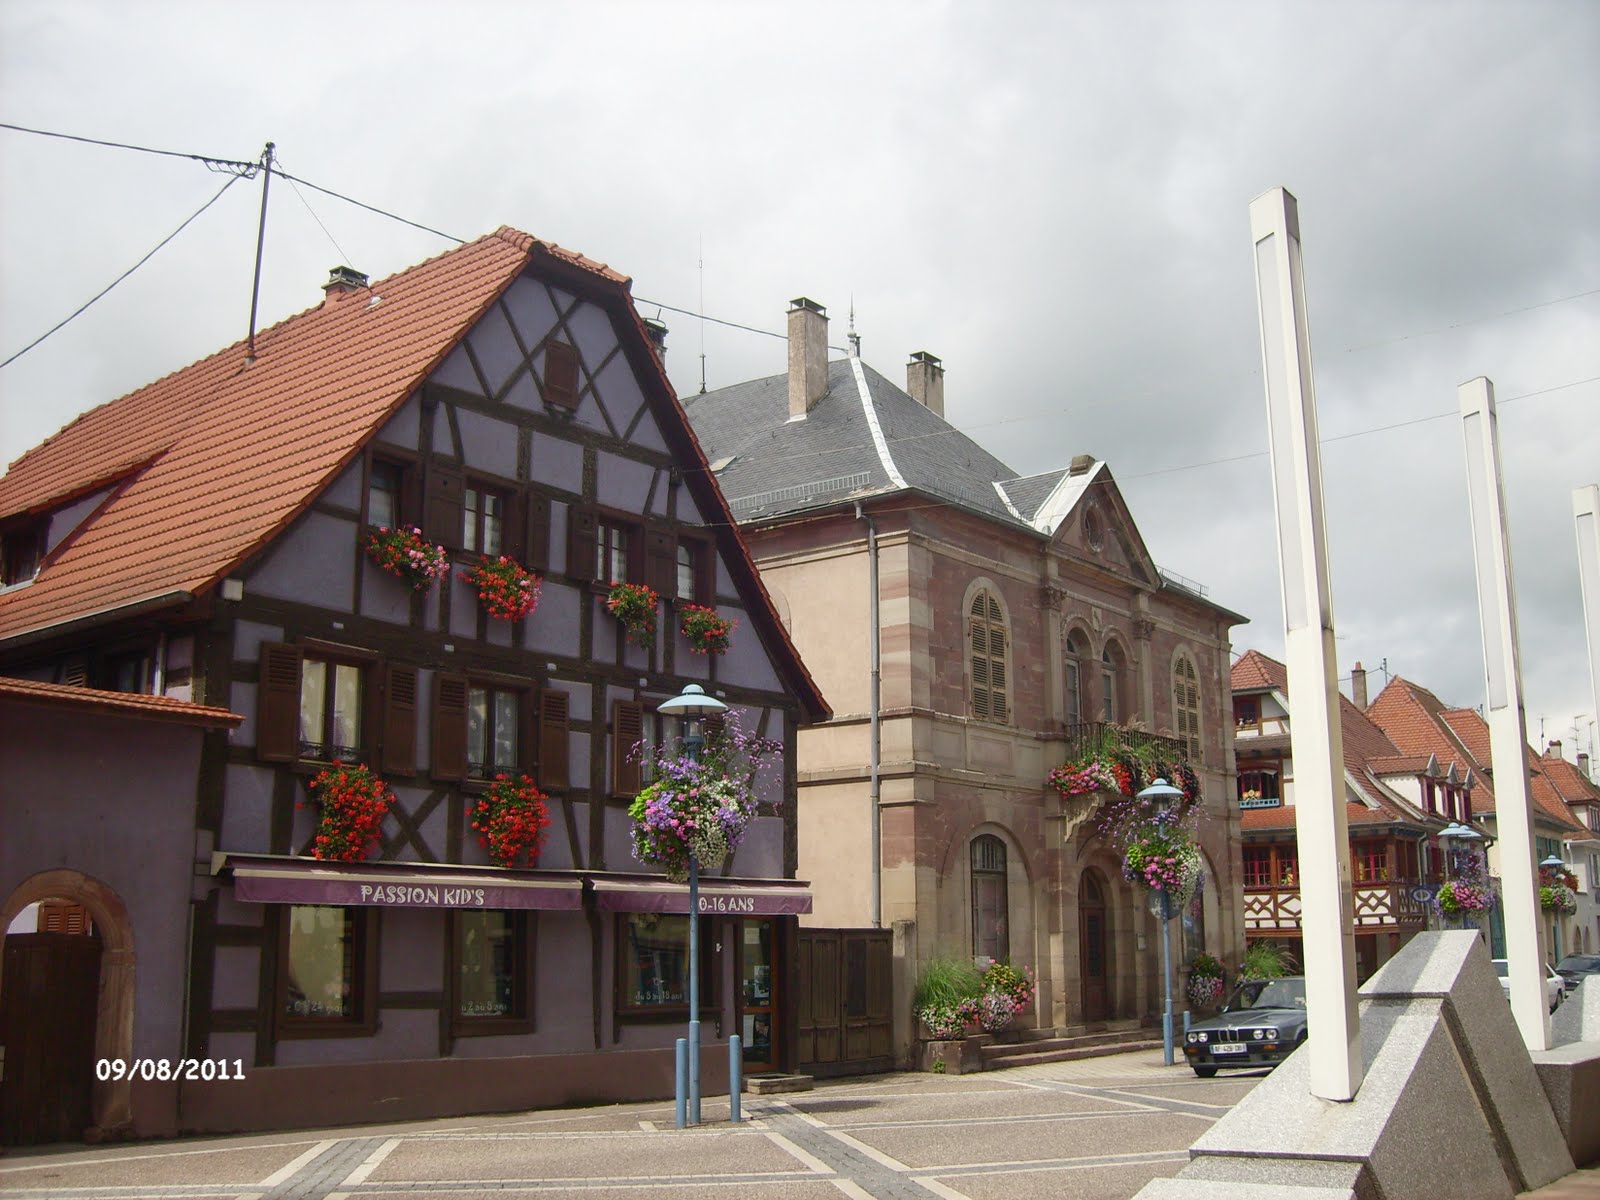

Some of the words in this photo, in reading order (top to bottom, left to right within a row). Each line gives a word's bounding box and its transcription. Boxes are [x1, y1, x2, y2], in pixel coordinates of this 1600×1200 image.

[361, 885, 439, 905] PASSION
[444, 888, 485, 906] KID'S
[698, 896, 726, 911] 0-16
[728, 897, 754, 912] ANS
